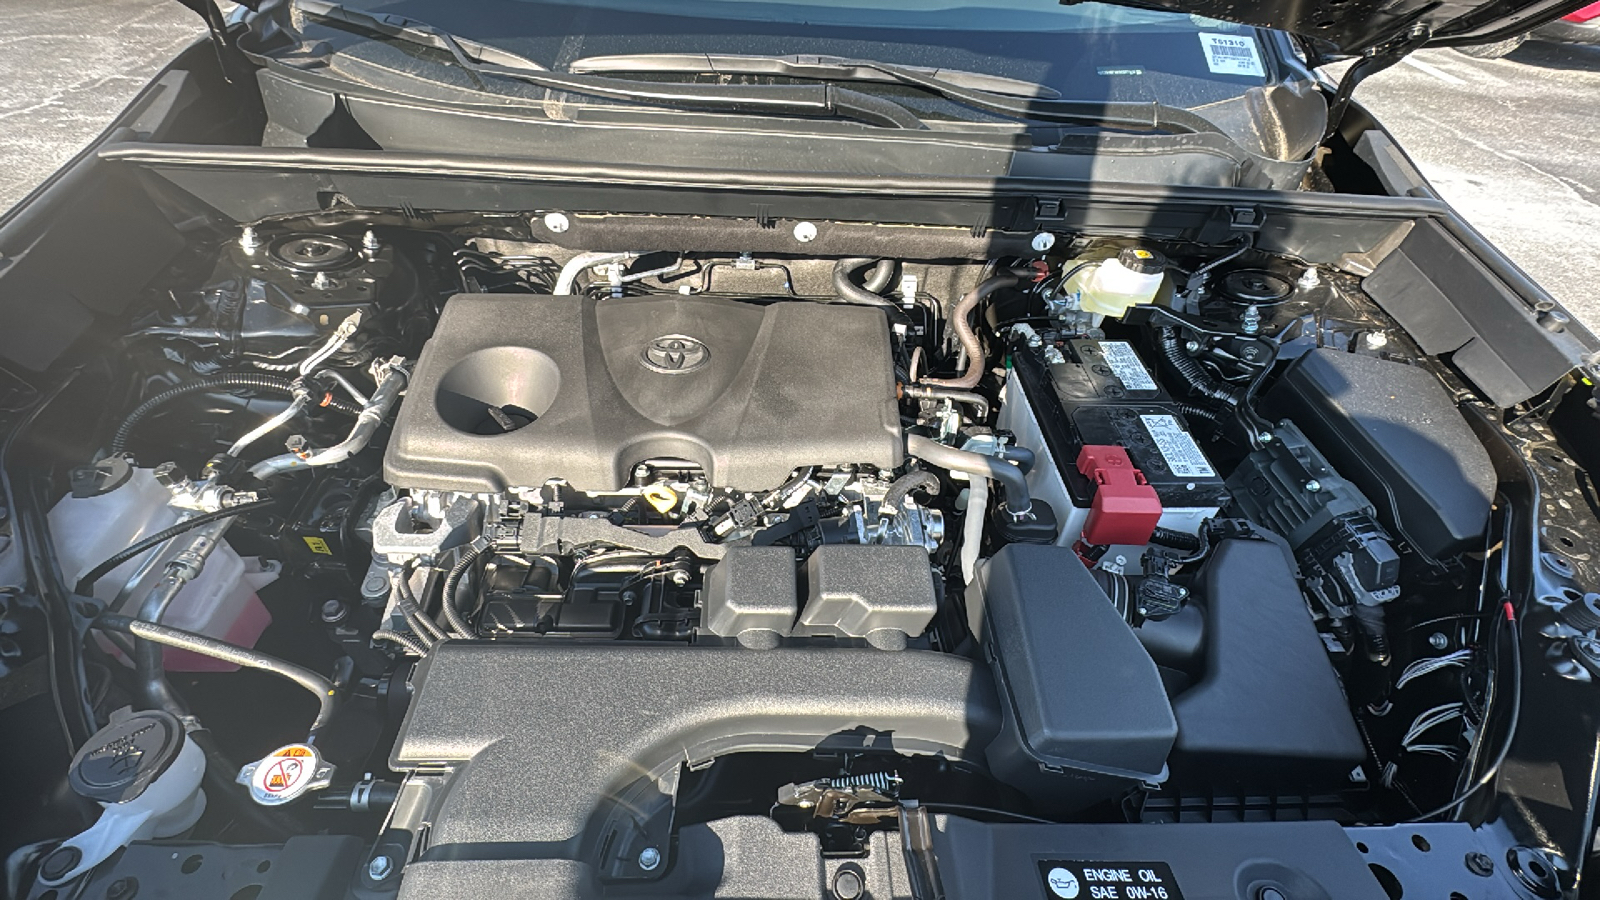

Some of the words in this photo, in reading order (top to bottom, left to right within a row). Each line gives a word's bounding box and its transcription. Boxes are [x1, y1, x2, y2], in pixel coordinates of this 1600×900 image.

[1083, 868, 1133, 882] ENGINE
[1138, 869, 1162, 882] OIL
[1090, 886, 1119, 899] SAE
[1126, 886, 1168, 899] 0W-16
